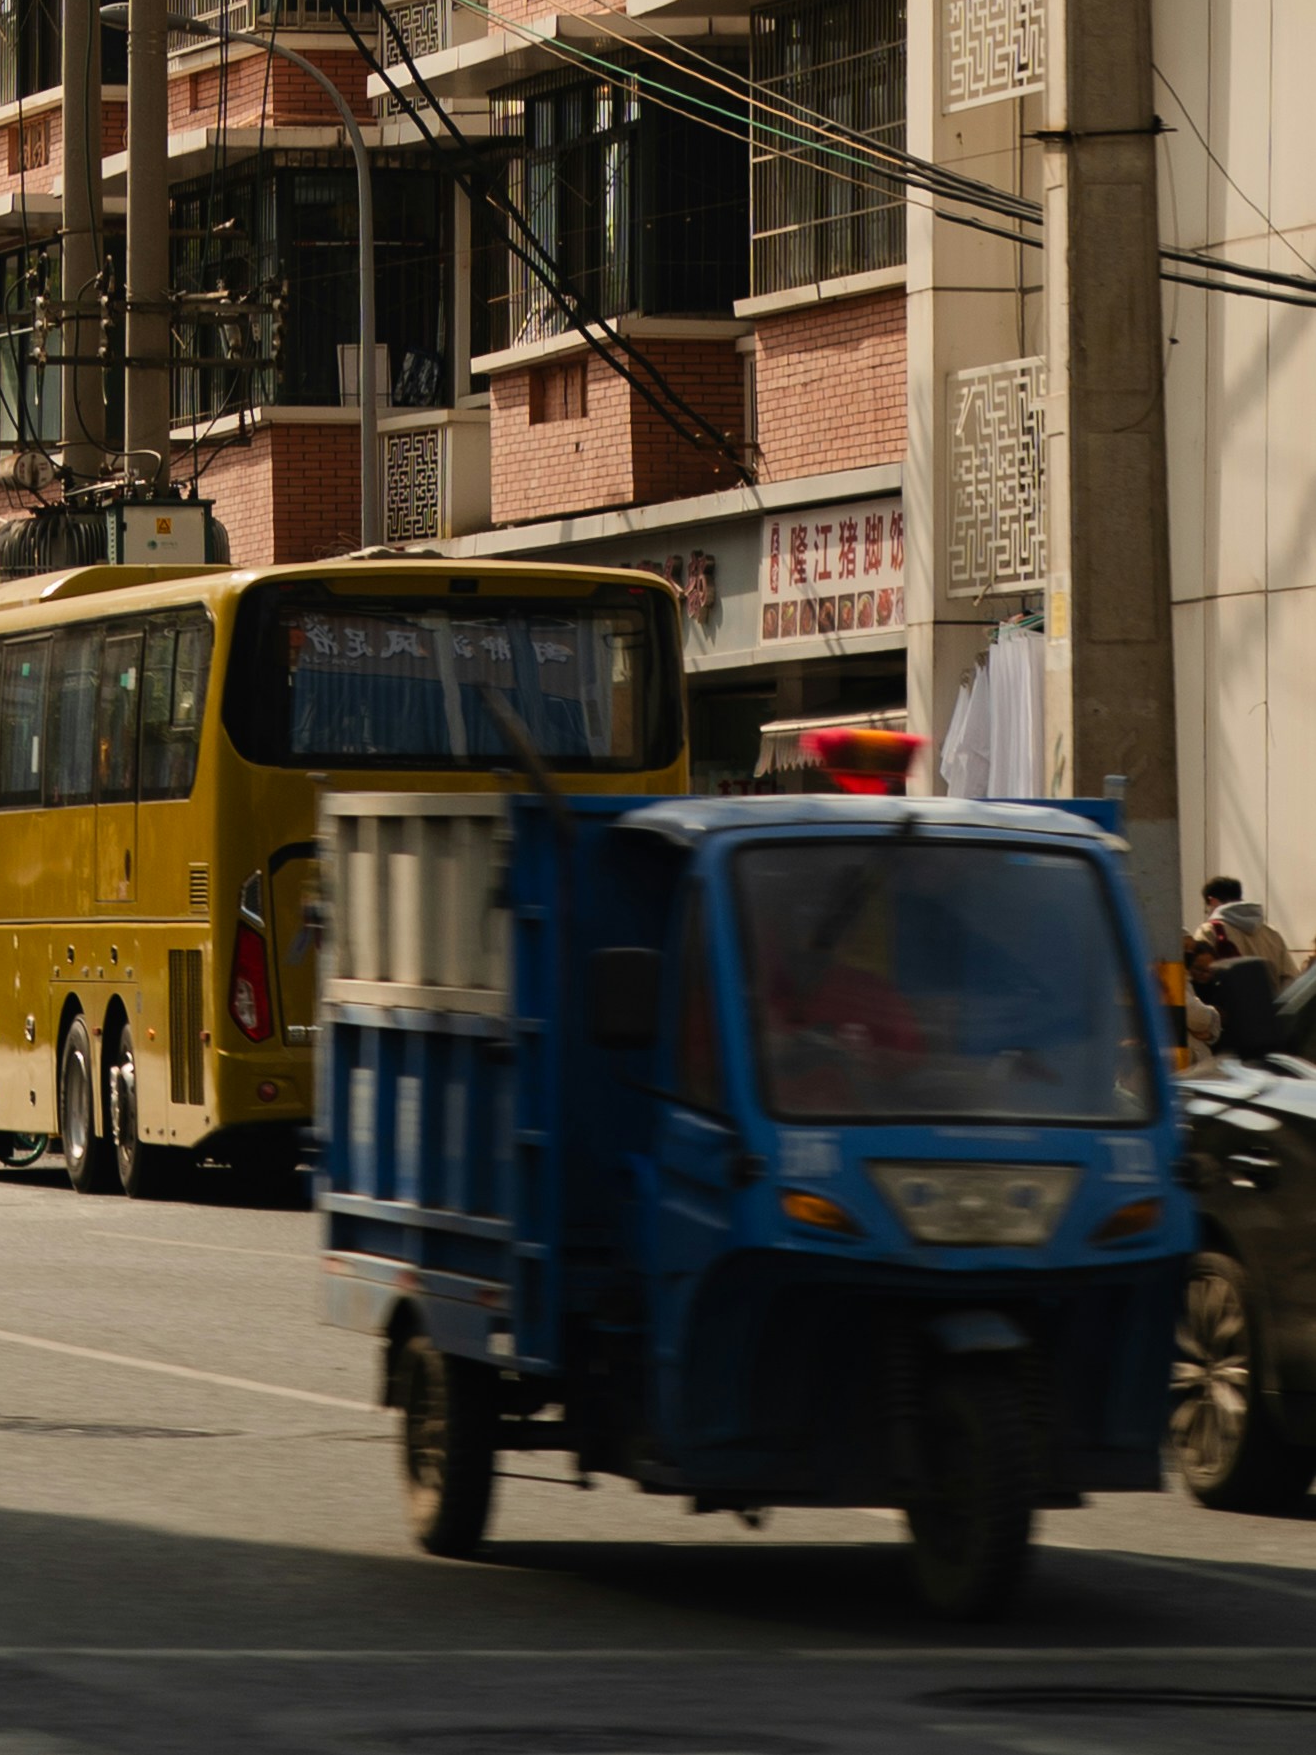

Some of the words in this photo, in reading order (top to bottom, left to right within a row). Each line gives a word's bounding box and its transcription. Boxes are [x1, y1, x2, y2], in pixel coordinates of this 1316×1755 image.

[789, 510, 904, 587] 隆江猪脚饭
